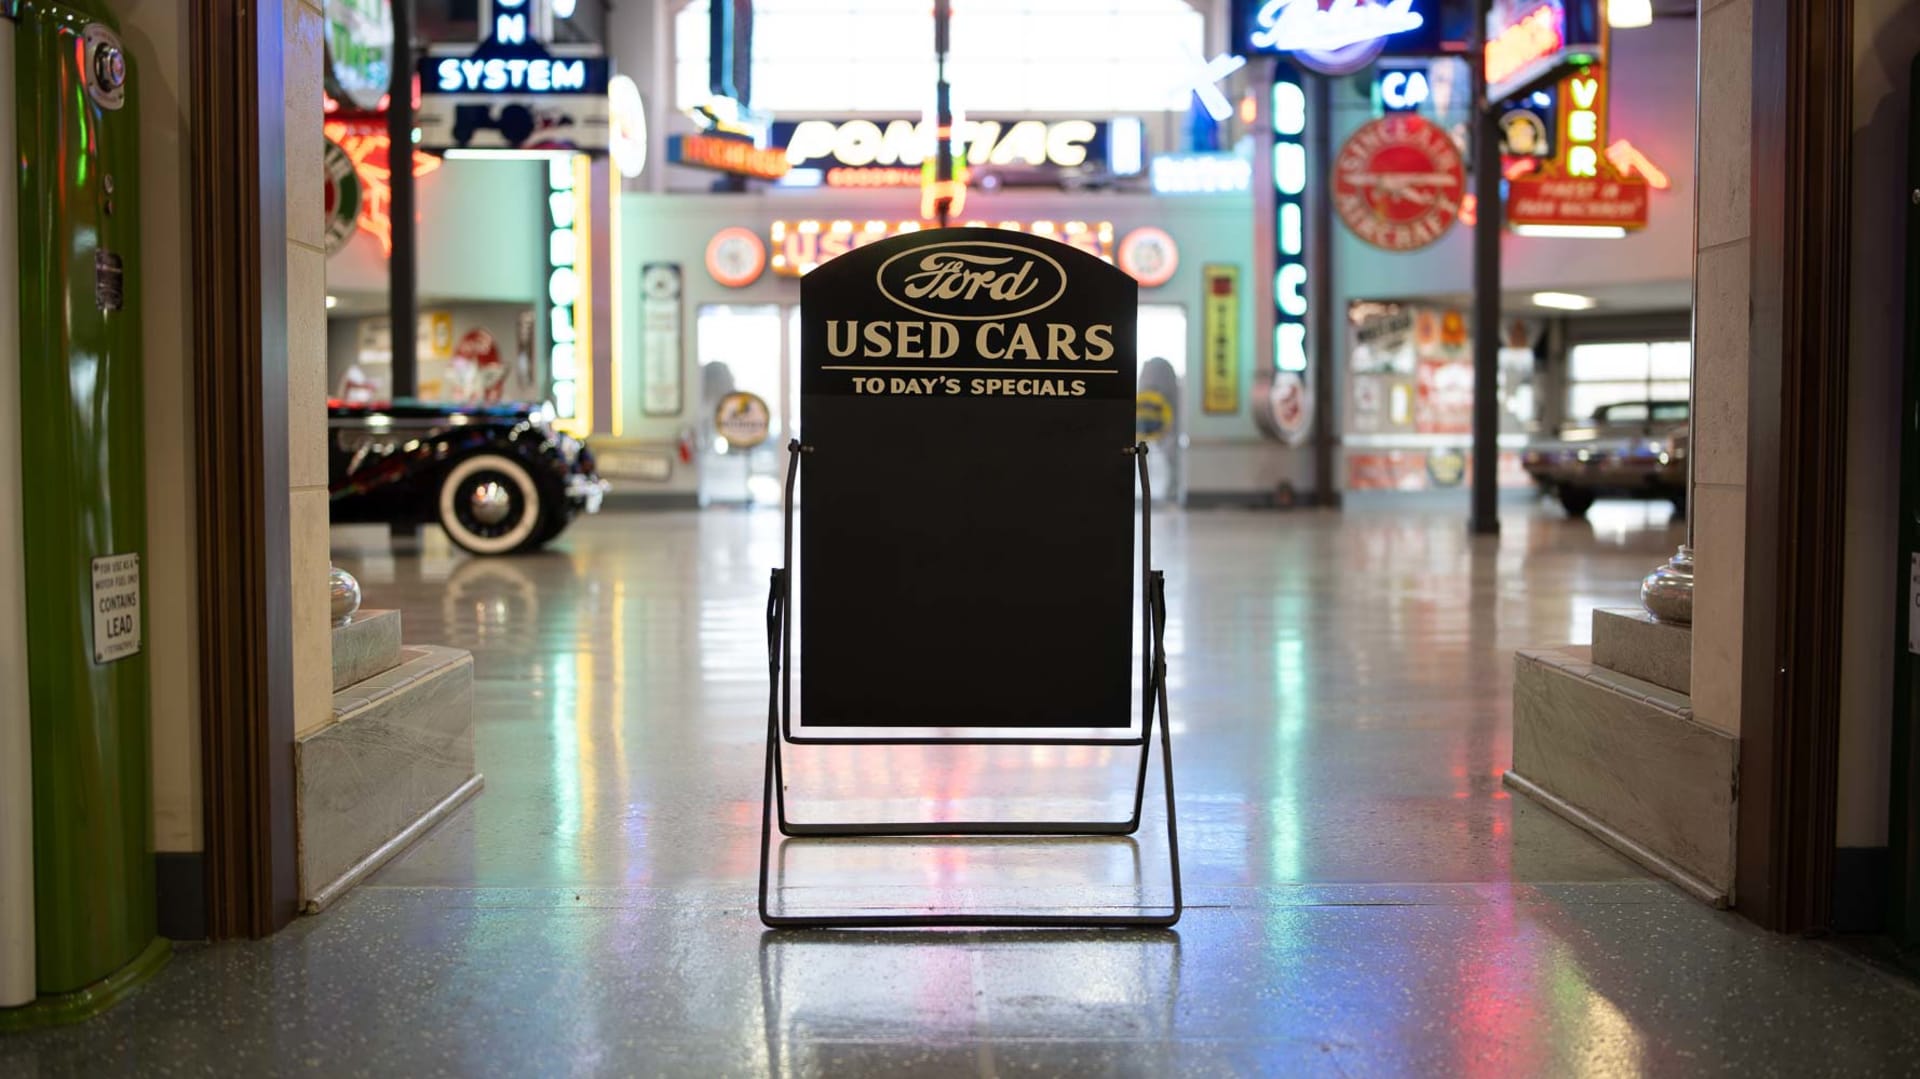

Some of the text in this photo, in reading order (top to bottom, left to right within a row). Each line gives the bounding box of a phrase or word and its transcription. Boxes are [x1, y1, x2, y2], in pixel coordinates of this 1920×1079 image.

[438, 58, 585, 90] SYSTEM
[1273, 81, 1307, 371] BUICK
[904, 252, 1039, 300] Ford
[825, 320, 1115, 362] USED CARS
[970, 379, 1087, 397] SPECIALS
[99, 592, 136, 613] CONTAINS
[107, 614, 132, 637] LEAD
